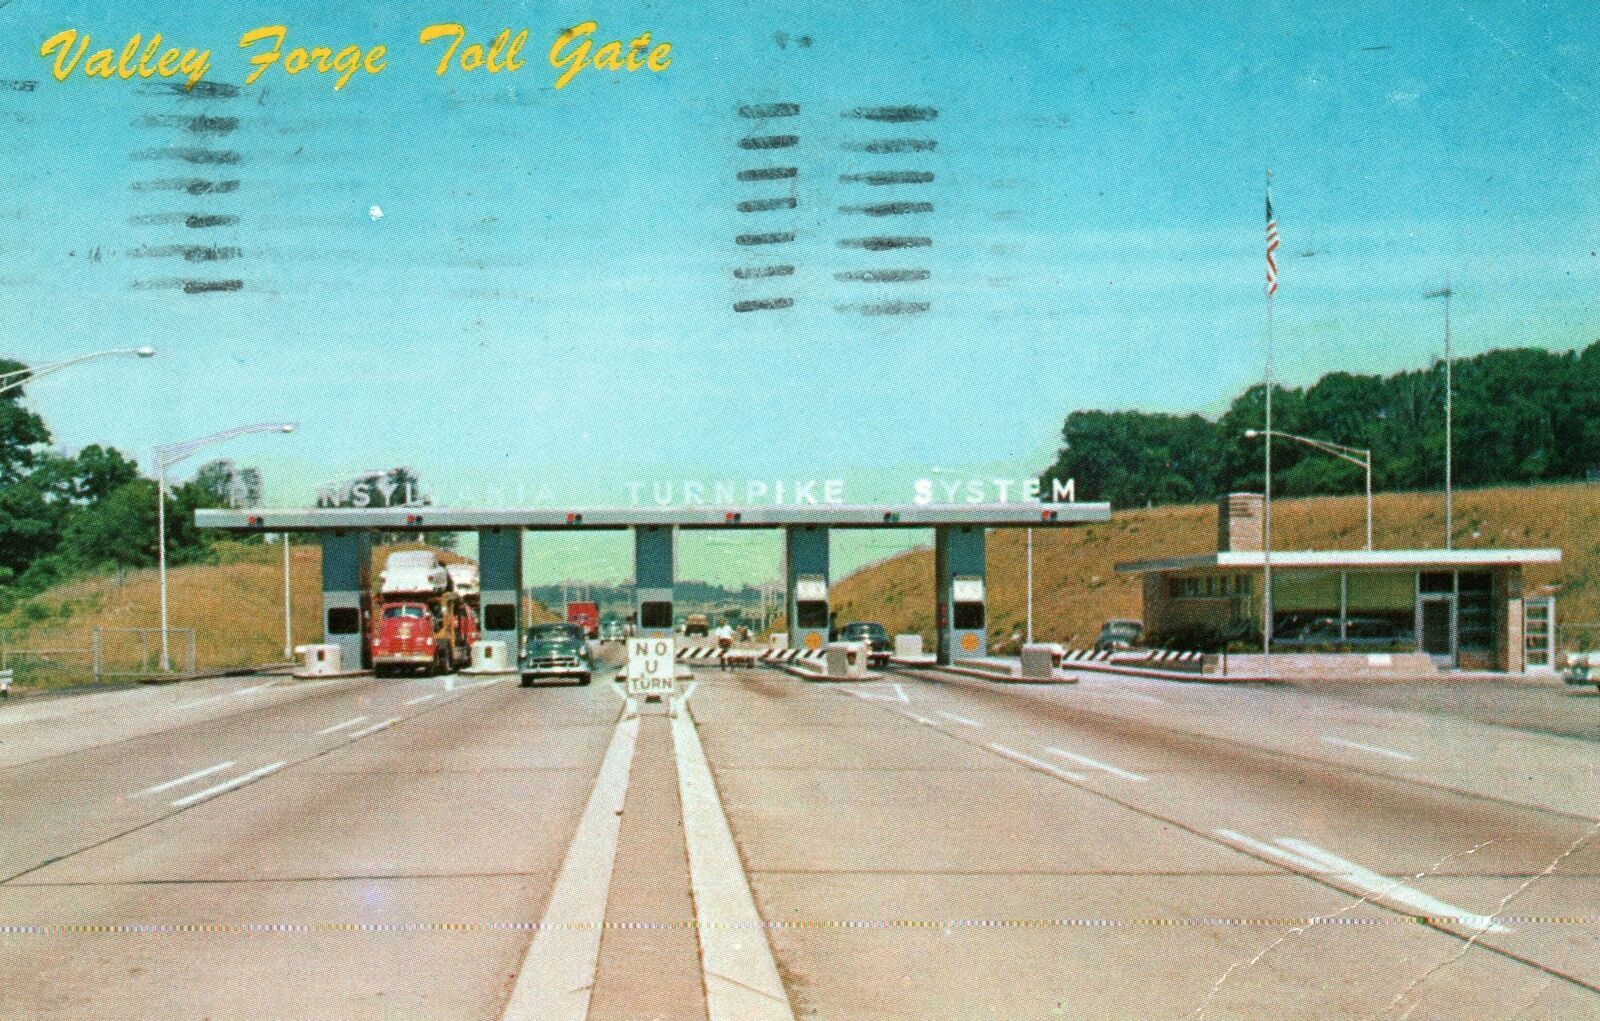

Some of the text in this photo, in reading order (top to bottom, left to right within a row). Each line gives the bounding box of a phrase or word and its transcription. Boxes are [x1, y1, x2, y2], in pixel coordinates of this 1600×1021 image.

[625, 479, 845, 505] TURNPIKE
[914, 478, 1076, 504] SYSTEM
[636, 642, 667, 656] NO
[645, 660, 658, 673] U
[631, 678, 673, 689] TURN
